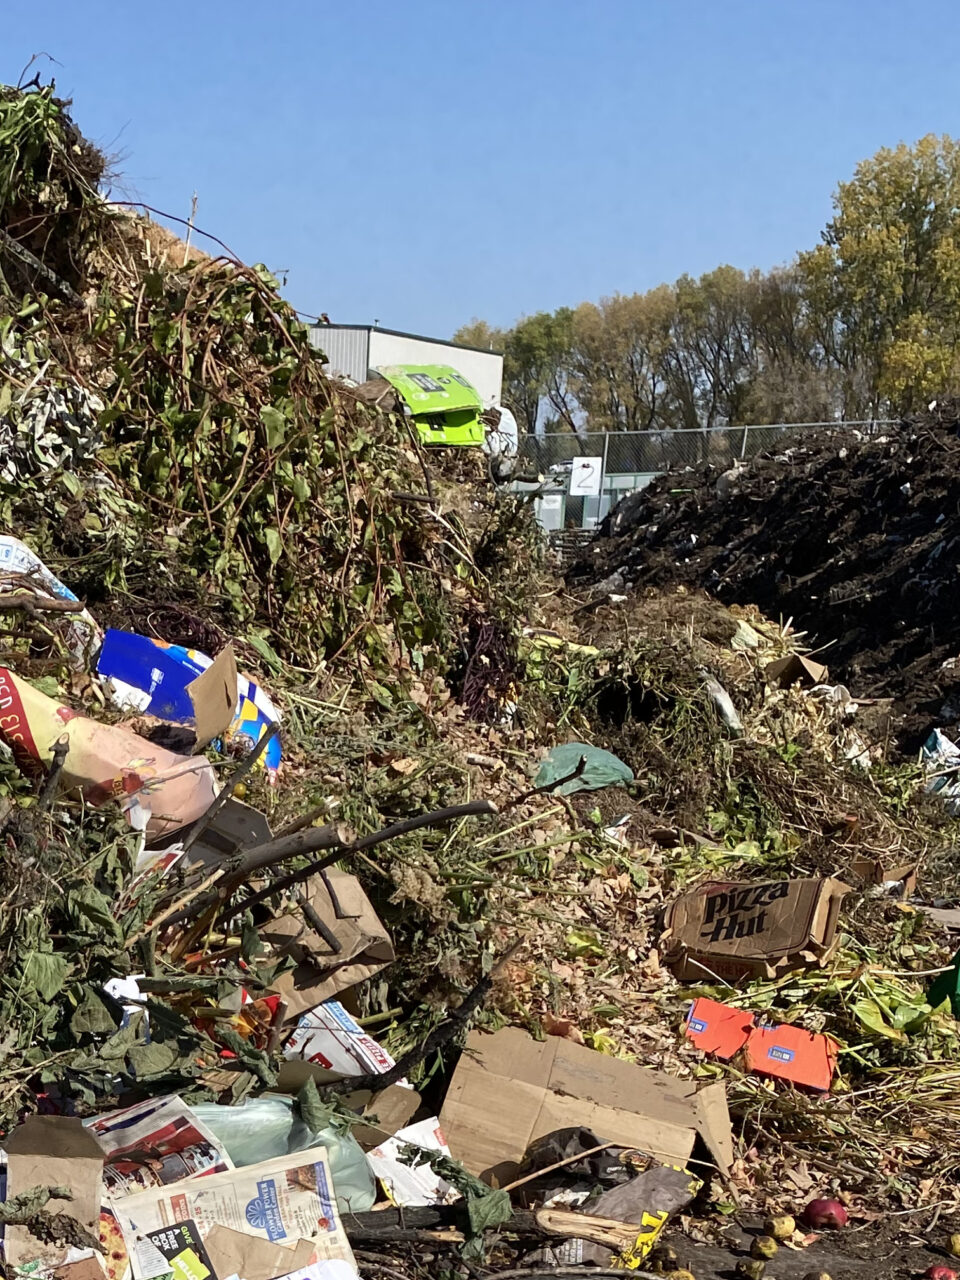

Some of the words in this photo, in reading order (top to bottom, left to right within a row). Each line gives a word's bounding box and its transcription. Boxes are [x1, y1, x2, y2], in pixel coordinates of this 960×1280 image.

[576, 463, 595, 489] 2
[703, 881, 790, 924] Pizza
[701, 909, 769, 943] Hut
[260, 1182, 273, 1209] POWER
[269, 1187, 277, 1207] Center
[266, 1210, 280, 1239] FLOWER
[272, 1208, 283, 1233] Garden
[151, 1236, 162, 1247] OF
[158, 1233, 172, 1251] BOX
[166, 1230, 179, 1250] FREE
[172, 1228, 181, 1236] A
[180, 1226, 193, 1245] GIVE
